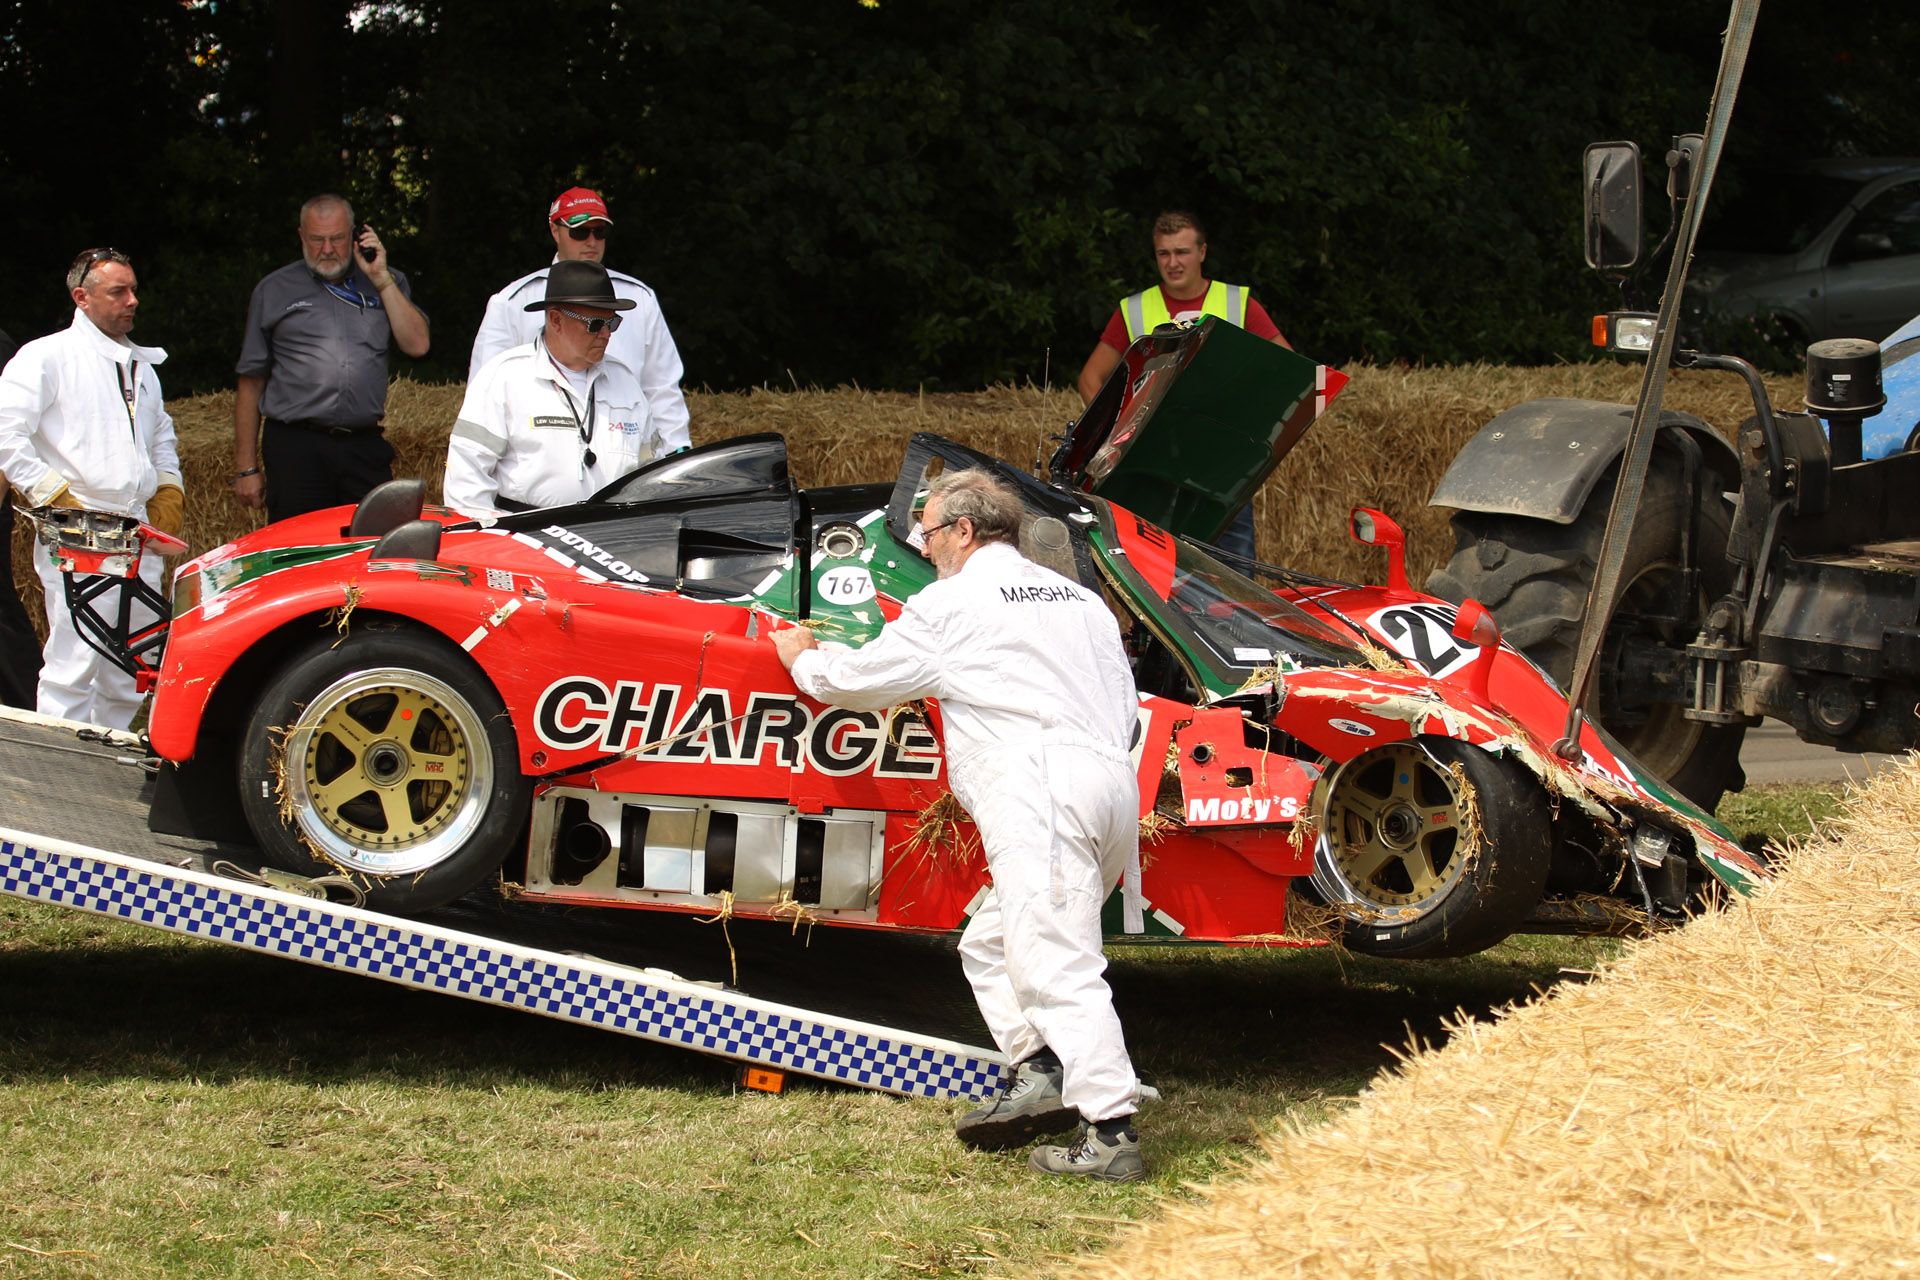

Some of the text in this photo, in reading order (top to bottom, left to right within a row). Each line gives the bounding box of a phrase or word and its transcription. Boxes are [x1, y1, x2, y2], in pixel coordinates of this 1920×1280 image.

[608, 422, 624, 432] 24
[540, 525, 650, 583] DUNLOP
[828, 576, 867, 595] 767
[1000, 586, 1088, 602] MARSHAL
[534, 676, 942, 780] CHARGE
[425, 764, 444, 773] MAG
[1189, 795, 1297, 822] Moty's
